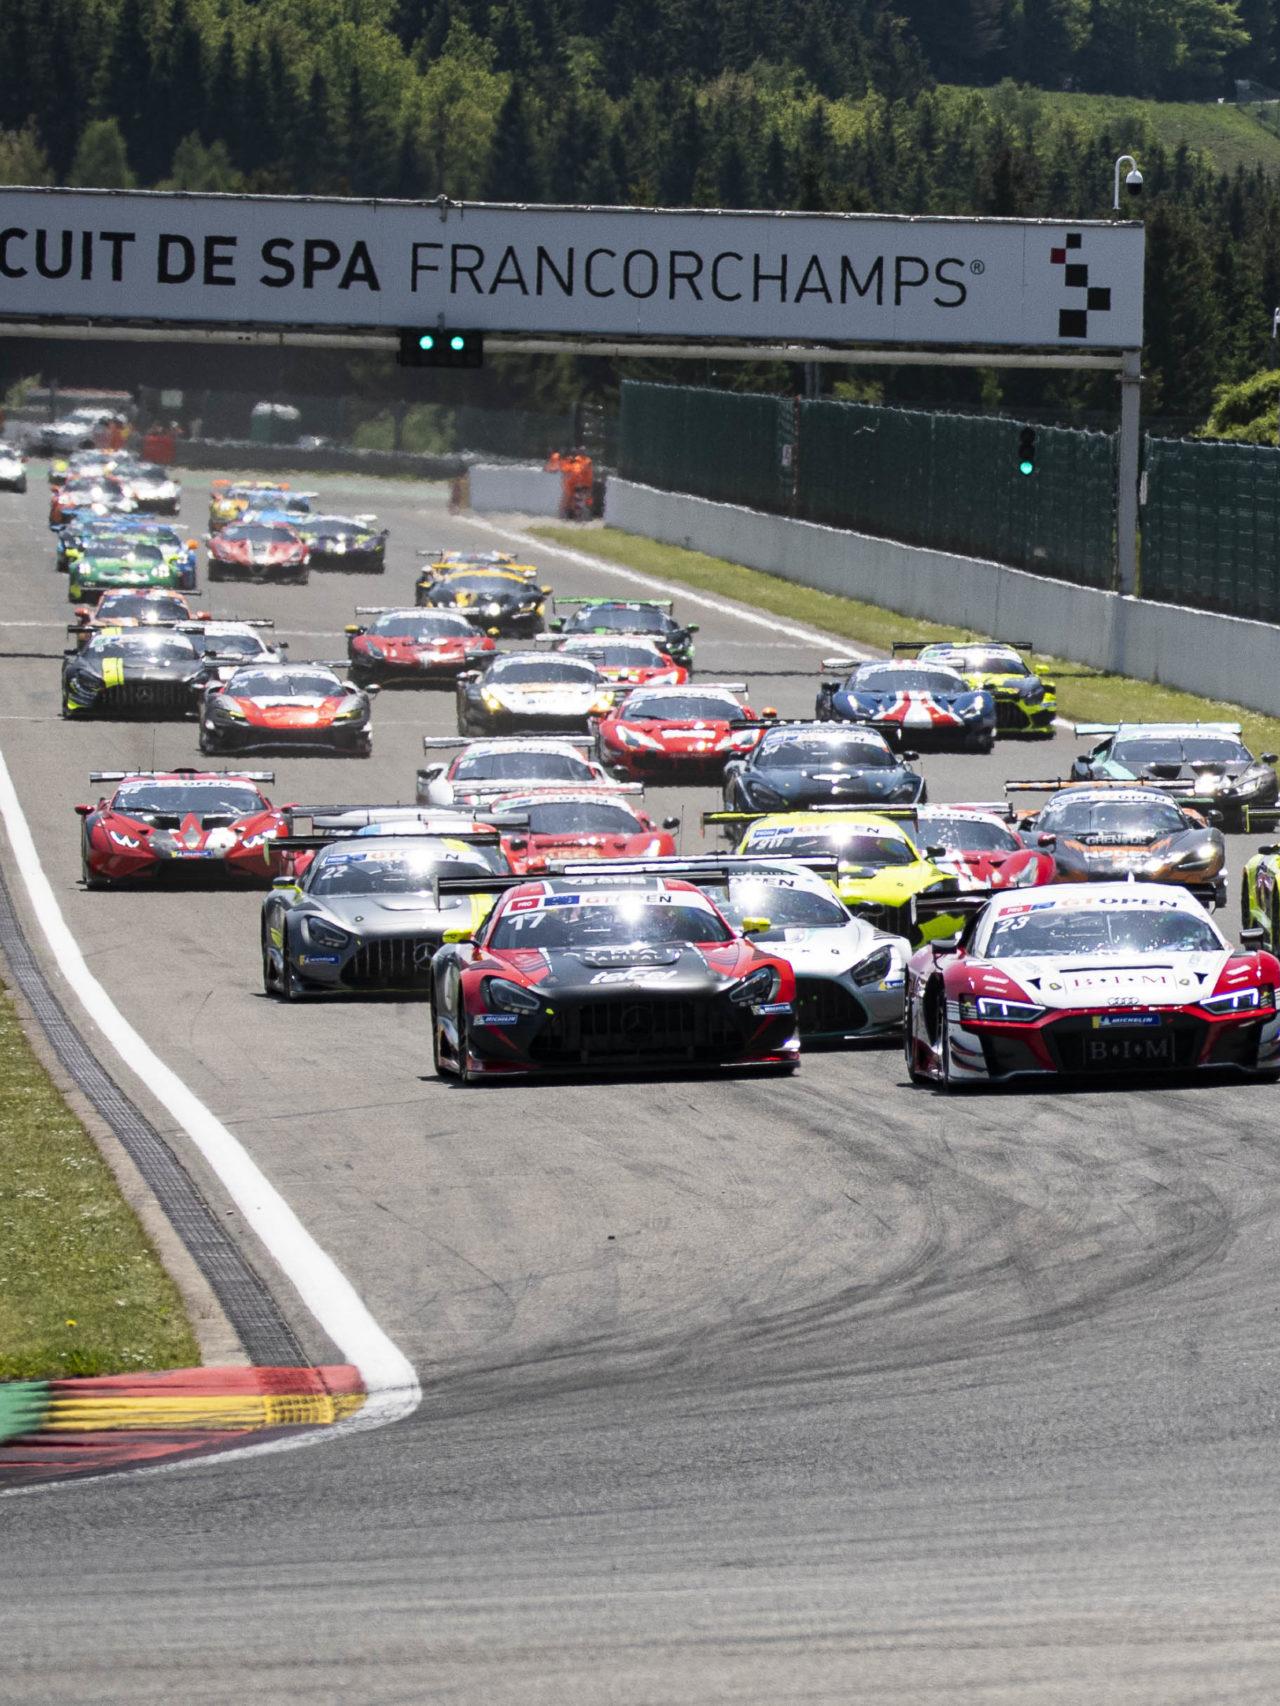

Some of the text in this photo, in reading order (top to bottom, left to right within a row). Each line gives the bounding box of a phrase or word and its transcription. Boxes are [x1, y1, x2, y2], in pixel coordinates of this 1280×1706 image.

[157, 233, 237, 286] DE
[260, 238, 380, 291] SPA
[1098, 897, 1178, 908] OPEN
[507, 912, 546, 931] 17
[995, 915, 1030, 935] 23
